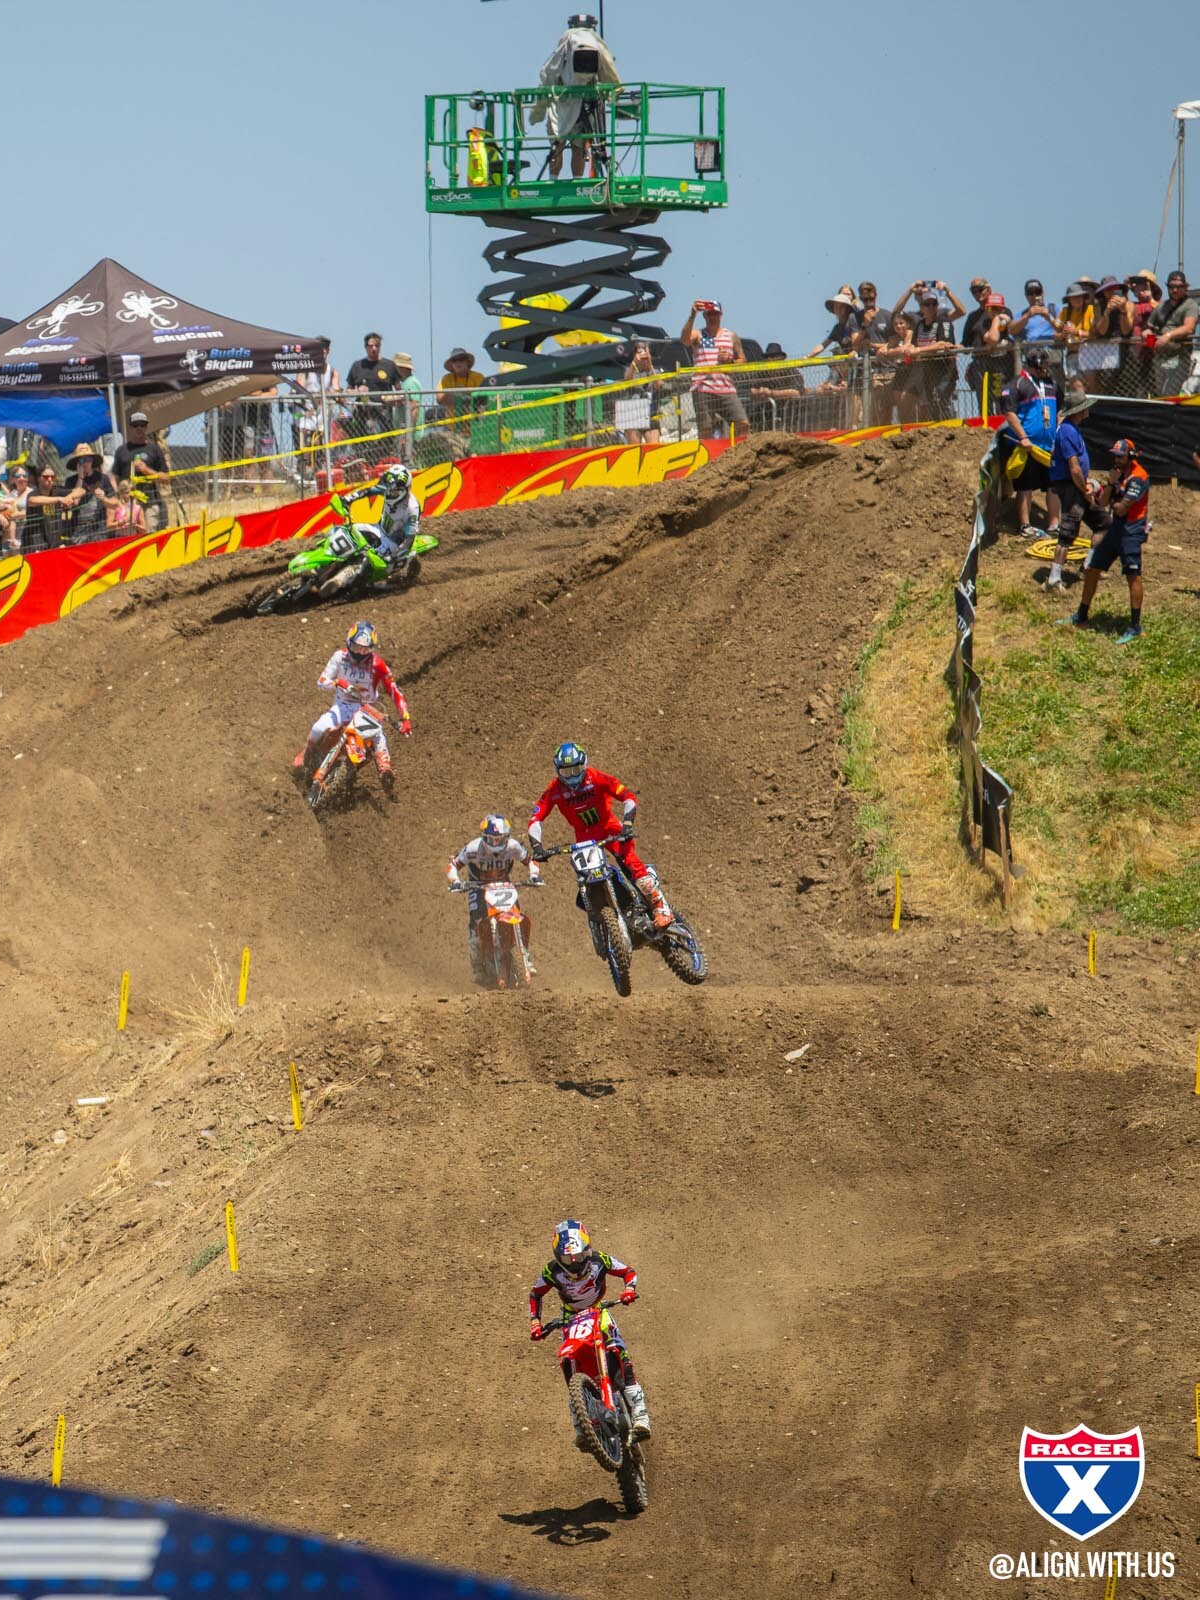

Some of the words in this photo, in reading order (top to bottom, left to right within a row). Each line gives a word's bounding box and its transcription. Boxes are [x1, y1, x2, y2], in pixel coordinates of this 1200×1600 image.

[431, 191, 472, 202] SKYJACK
[647, 186, 680, 198] SKYJACK
[210, 348, 251, 359] Budds
[205, 359, 254, 371] SkyCam
[330, 535, 352, 556] 9
[355, 715, 380, 732] 7
[493, 891, 513, 907] 2
[569, 1319, 595, 1340] 18
